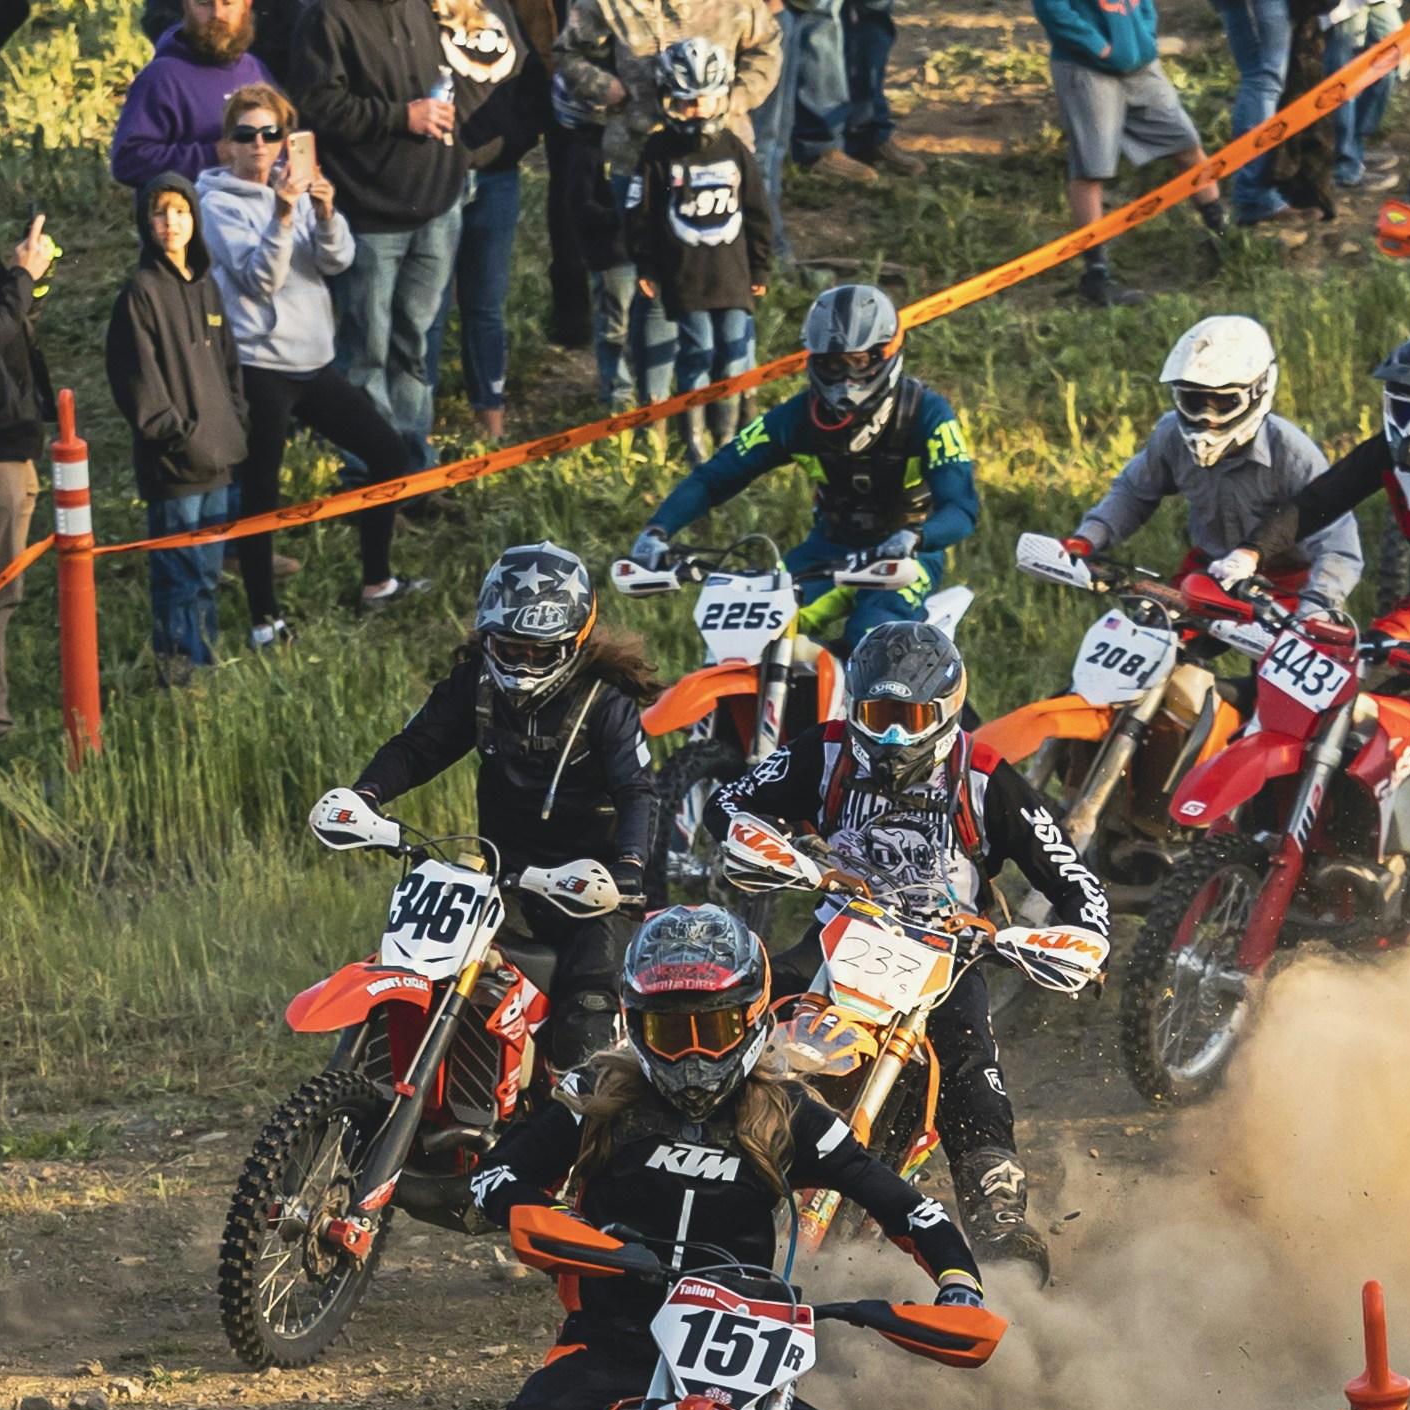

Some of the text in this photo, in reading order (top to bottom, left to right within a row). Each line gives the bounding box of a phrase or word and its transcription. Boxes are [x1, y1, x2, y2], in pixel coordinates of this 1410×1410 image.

[731, 823, 796, 868] KTM
[838, 936, 922, 978] 237
[1025, 930, 1104, 961] KTM
[645, 1142, 741, 1182] KTM
